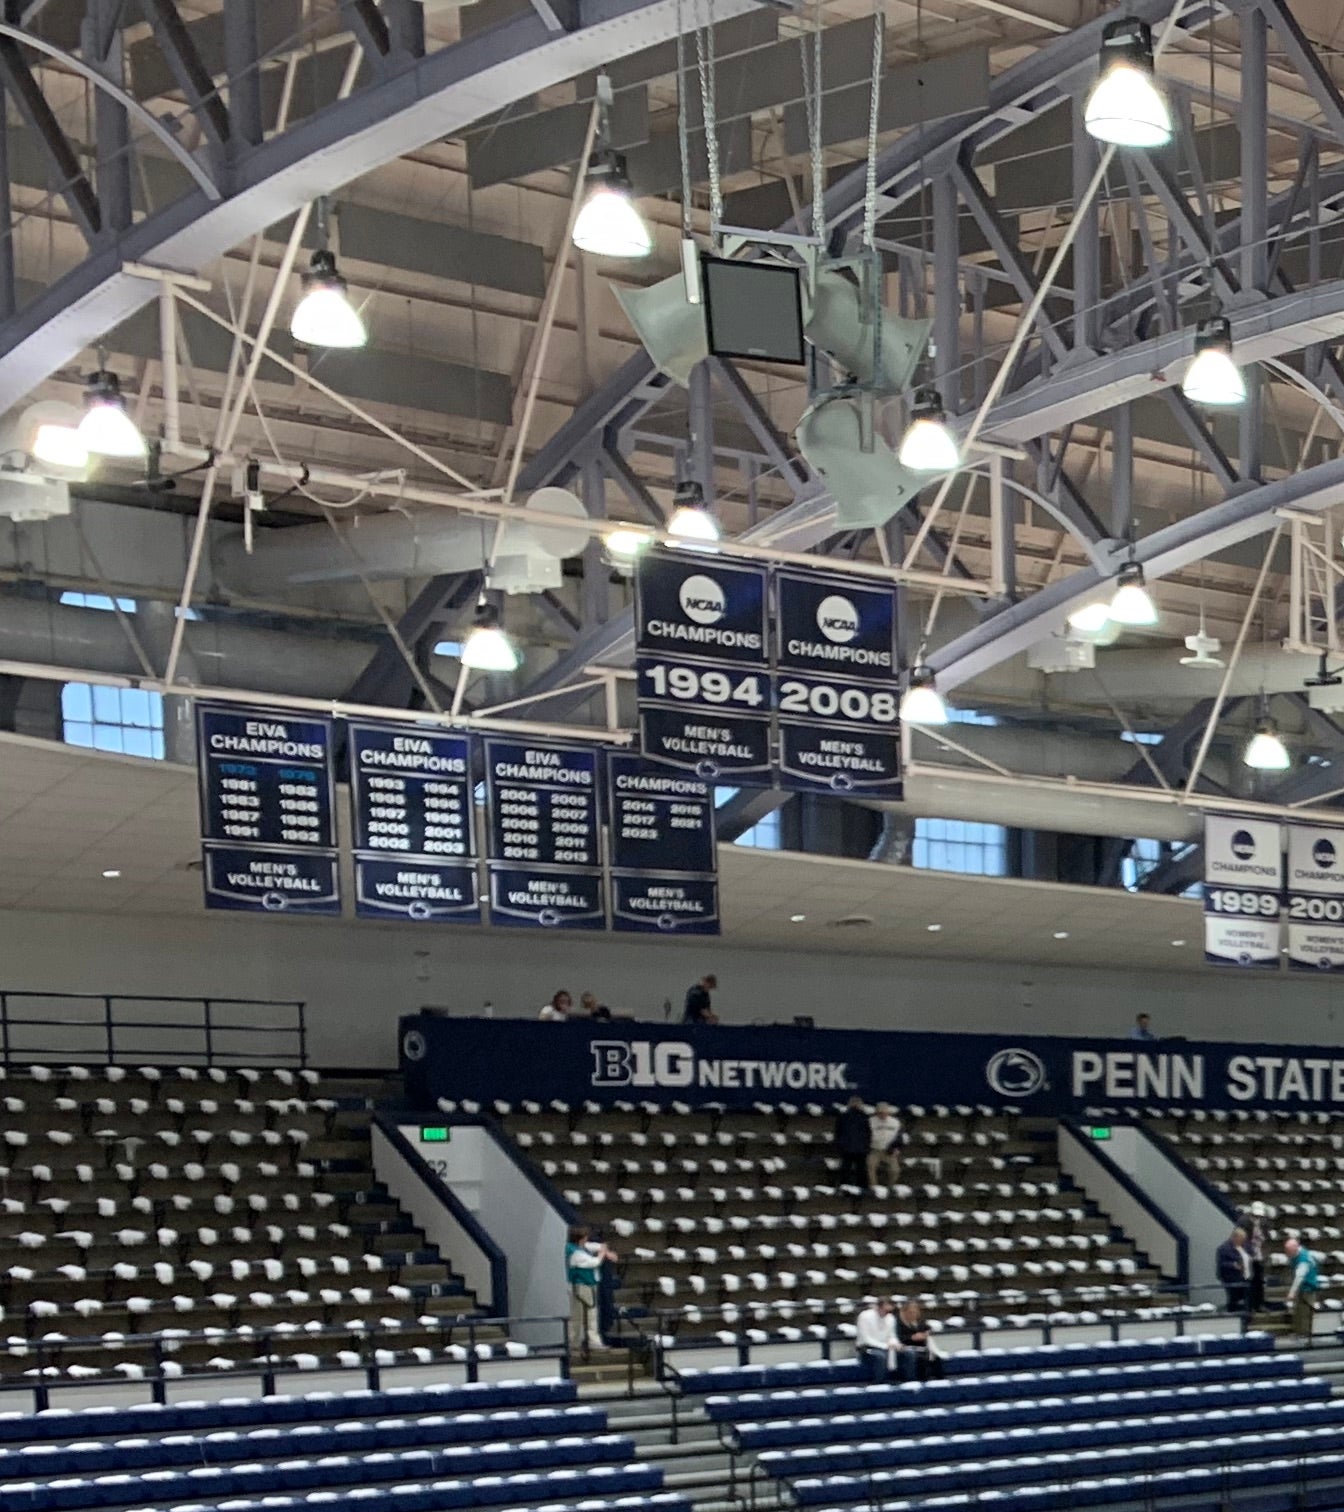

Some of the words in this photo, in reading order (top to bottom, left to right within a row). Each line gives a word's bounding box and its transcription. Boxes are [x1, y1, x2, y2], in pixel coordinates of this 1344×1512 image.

[686, 598, 724, 615] NCAA
[648, 620, 761, 648] CHAMPIONS
[823, 617, 858, 634] NCAA
[788, 640, 891, 666] CHAMPIONS
[646, 665, 762, 706] 1994
[780, 682, 896, 722] 2008
[246, 722, 287, 739] EIVA
[685, 724, 732, 741] MEN'S
[211, 735, 323, 758] CHAMPIONS
[394, 738, 432, 753] EIVA
[662, 737, 753, 758] VOLLEYBALL
[820, 740, 864, 755] MEN'S
[360, 750, 465, 773] CHAMPIONS
[525, 751, 560, 766] EIVA
[799, 752, 885, 771] VOLLEYBALL
[496, 763, 591, 784] CHAMPIONS
[616, 775, 707, 795] CHAMPIONS
[250, 862, 297, 876] MEN'S
[1212, 862, 1276, 877] CHAMPIONS
[227, 873, 320, 891] VOLLEYBALL
[398, 872, 441, 885] MEN'S
[528, 880, 569, 893] MEN'S
[376, 884, 462, 900] VOLLEYBALL
[509, 892, 587, 908] VOLLEYBALL
[648, 887, 685, 899] MEN'S
[629, 898, 703, 912] VOLLEYBALL
[1210, 891, 1277, 915] 1999
[699, 1059, 848, 1090] NETWORK
[1073, 1051, 1202, 1098] PENN
